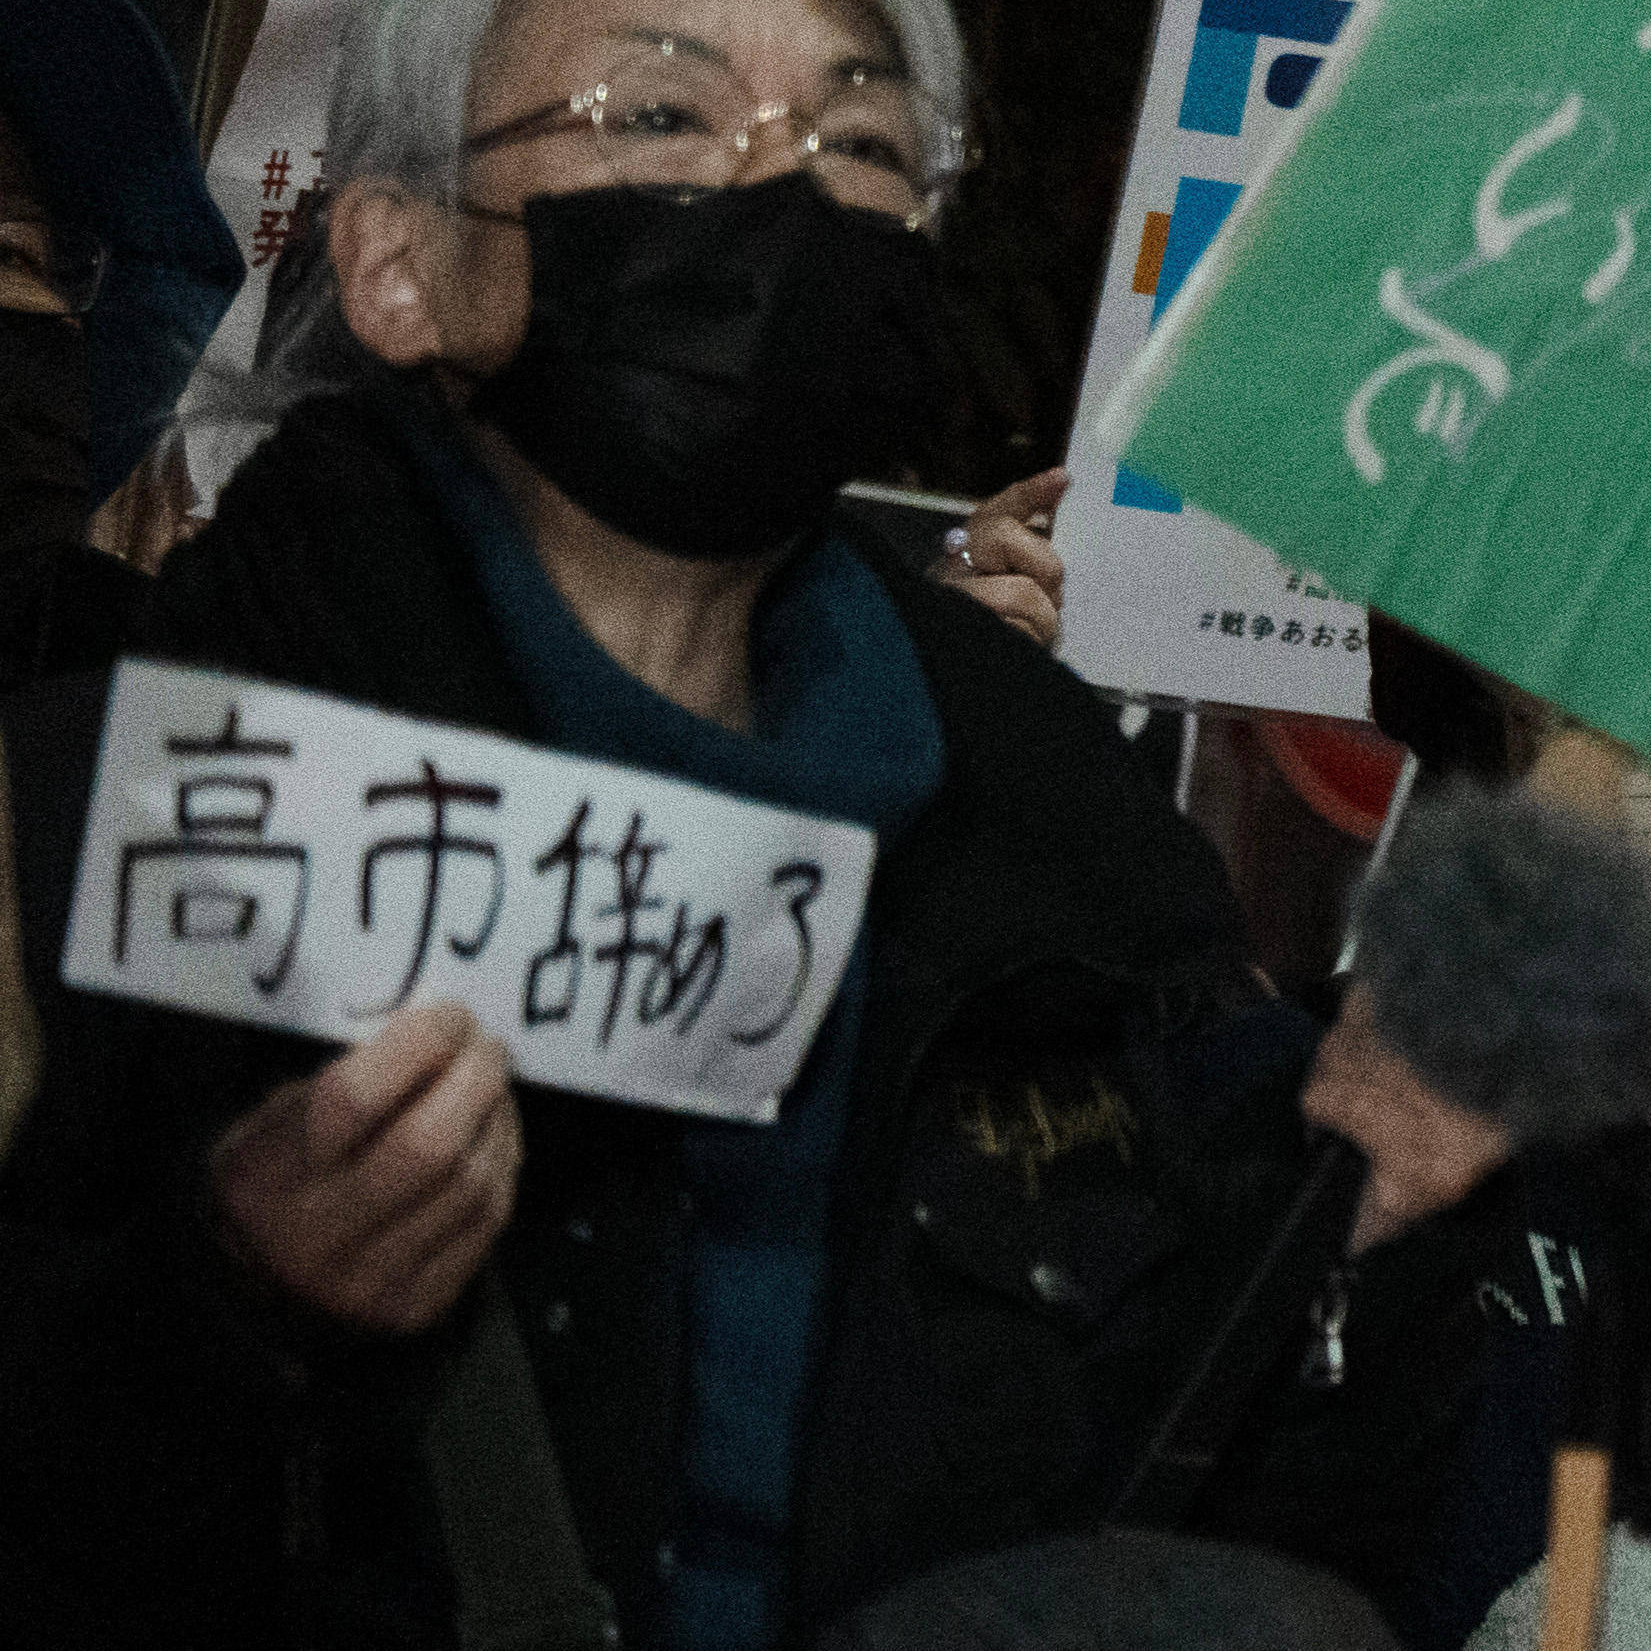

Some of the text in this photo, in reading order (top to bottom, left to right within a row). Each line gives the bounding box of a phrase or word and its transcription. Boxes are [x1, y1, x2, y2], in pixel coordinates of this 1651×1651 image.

[1198, 607, 1370, 653] #戦争あおる
[115, 700, 826, 1048] 高市辞めろ
